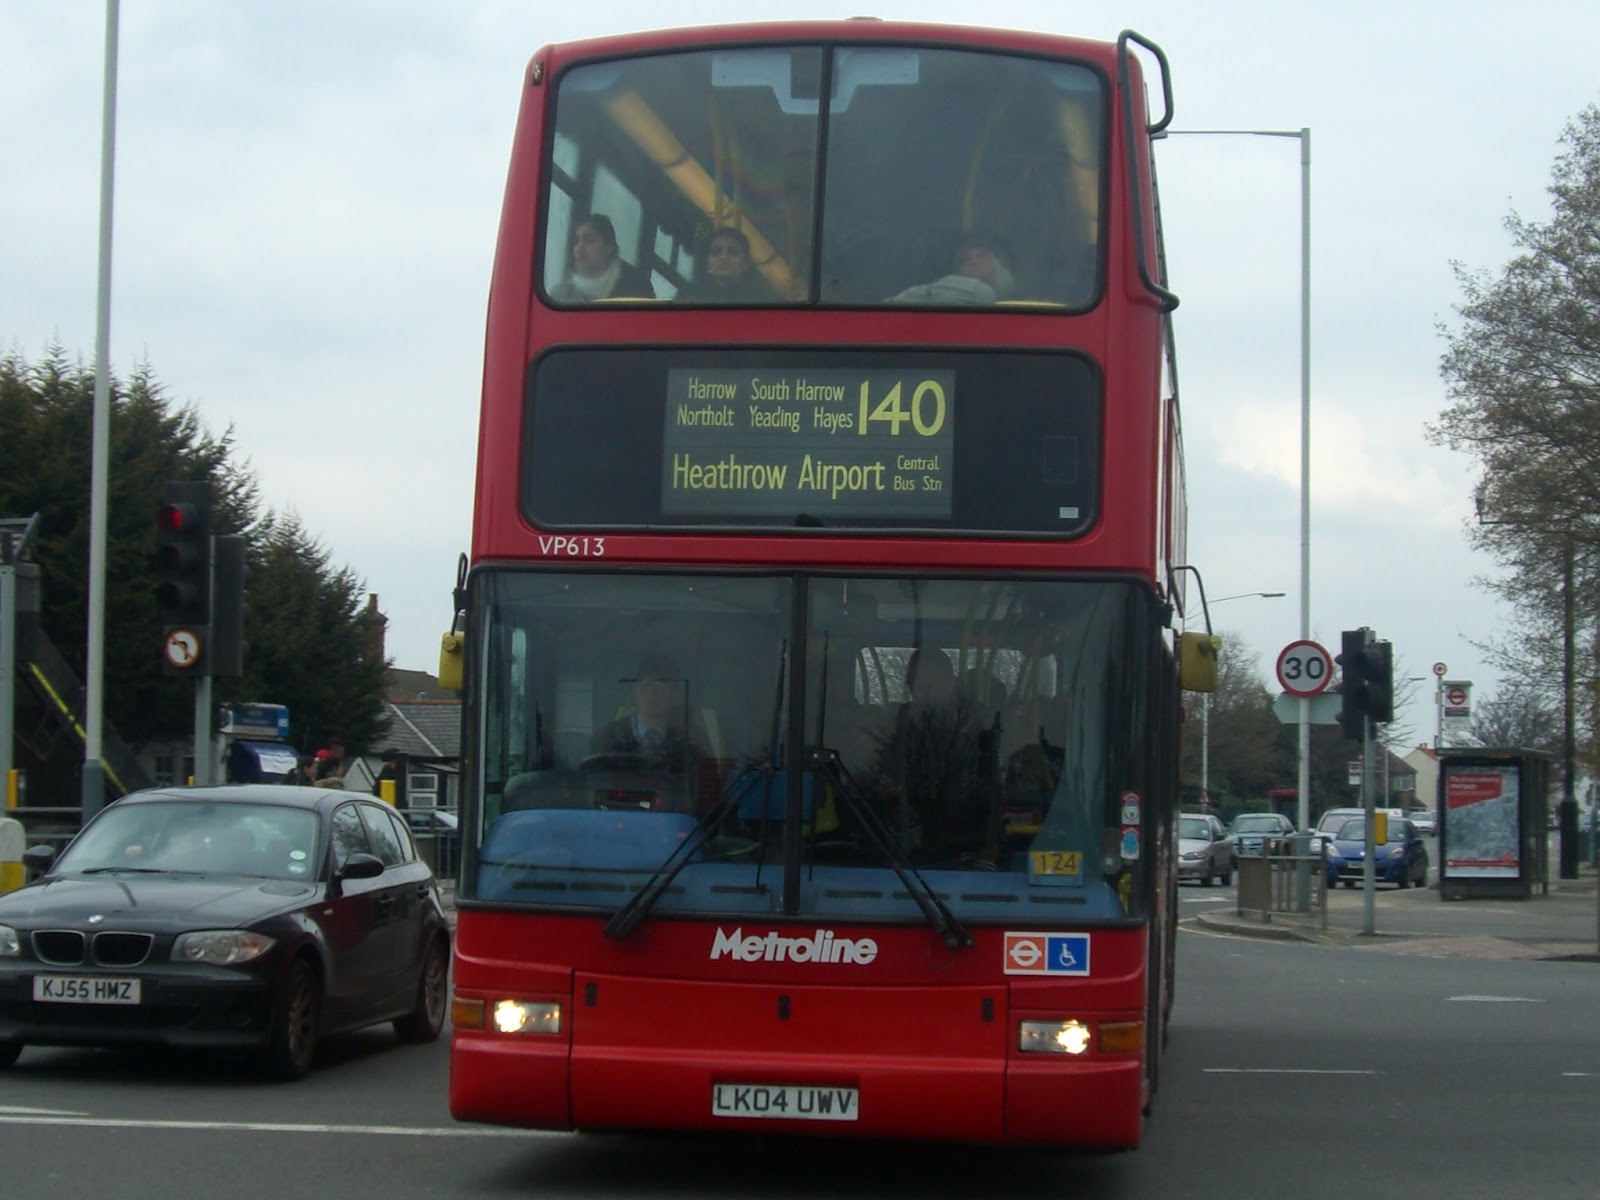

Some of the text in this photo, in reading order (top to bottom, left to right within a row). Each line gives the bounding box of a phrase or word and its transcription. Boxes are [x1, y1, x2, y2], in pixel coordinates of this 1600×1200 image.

[688, 377, 845, 401] Harrow South Harrow
[676, 404, 853, 435] Northolt Yeading Hayes
[857, 379, 946, 437] 140
[896, 455, 940, 471] Central
[672, 453, 885, 500] Heathrow Airport
[893, 475, 942, 492] Bus Stn
[538, 536, 605, 557] VP613
[1284, 656, 1326, 680] 30
[1040, 852, 1078, 872] 124
[709, 926, 879, 966] Metroline
[42, 979, 132, 1000] KJ55 HMZ
[716, 1086, 853, 1114] LK04 UWV
